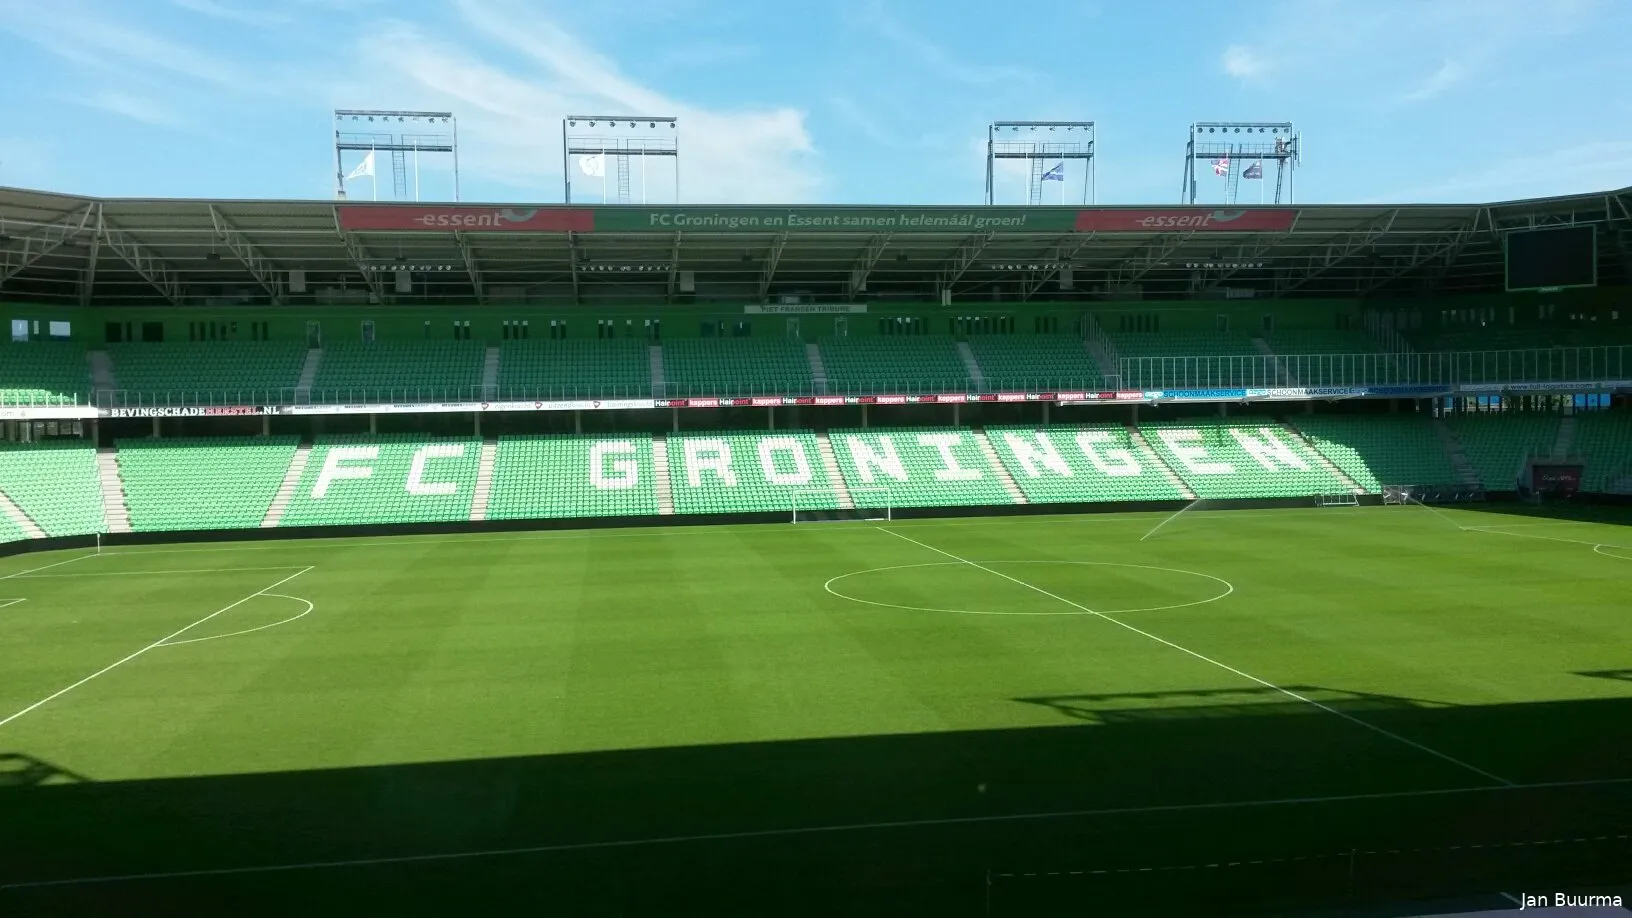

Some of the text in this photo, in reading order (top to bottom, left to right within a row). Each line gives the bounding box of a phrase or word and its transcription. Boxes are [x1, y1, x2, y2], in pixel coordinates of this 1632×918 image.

[422, 211, 502, 227] essent
[650, 213, 1027, 229] FC Groningen en Essent samen helemáál groen!
[1141, 213, 1212, 227] essent
[818, 304, 850, 313] TRIBUNE
[1164, 389, 1247, 398] SCHOONMAAKSERVICE
[1266, 388, 1349, 397] SCHOONMAAKSERVICE
[110, 405, 280, 418] BEVINGSCHADEHERSTEL.NL
[310, 426, 1312, 499] FC GRONINGEN
